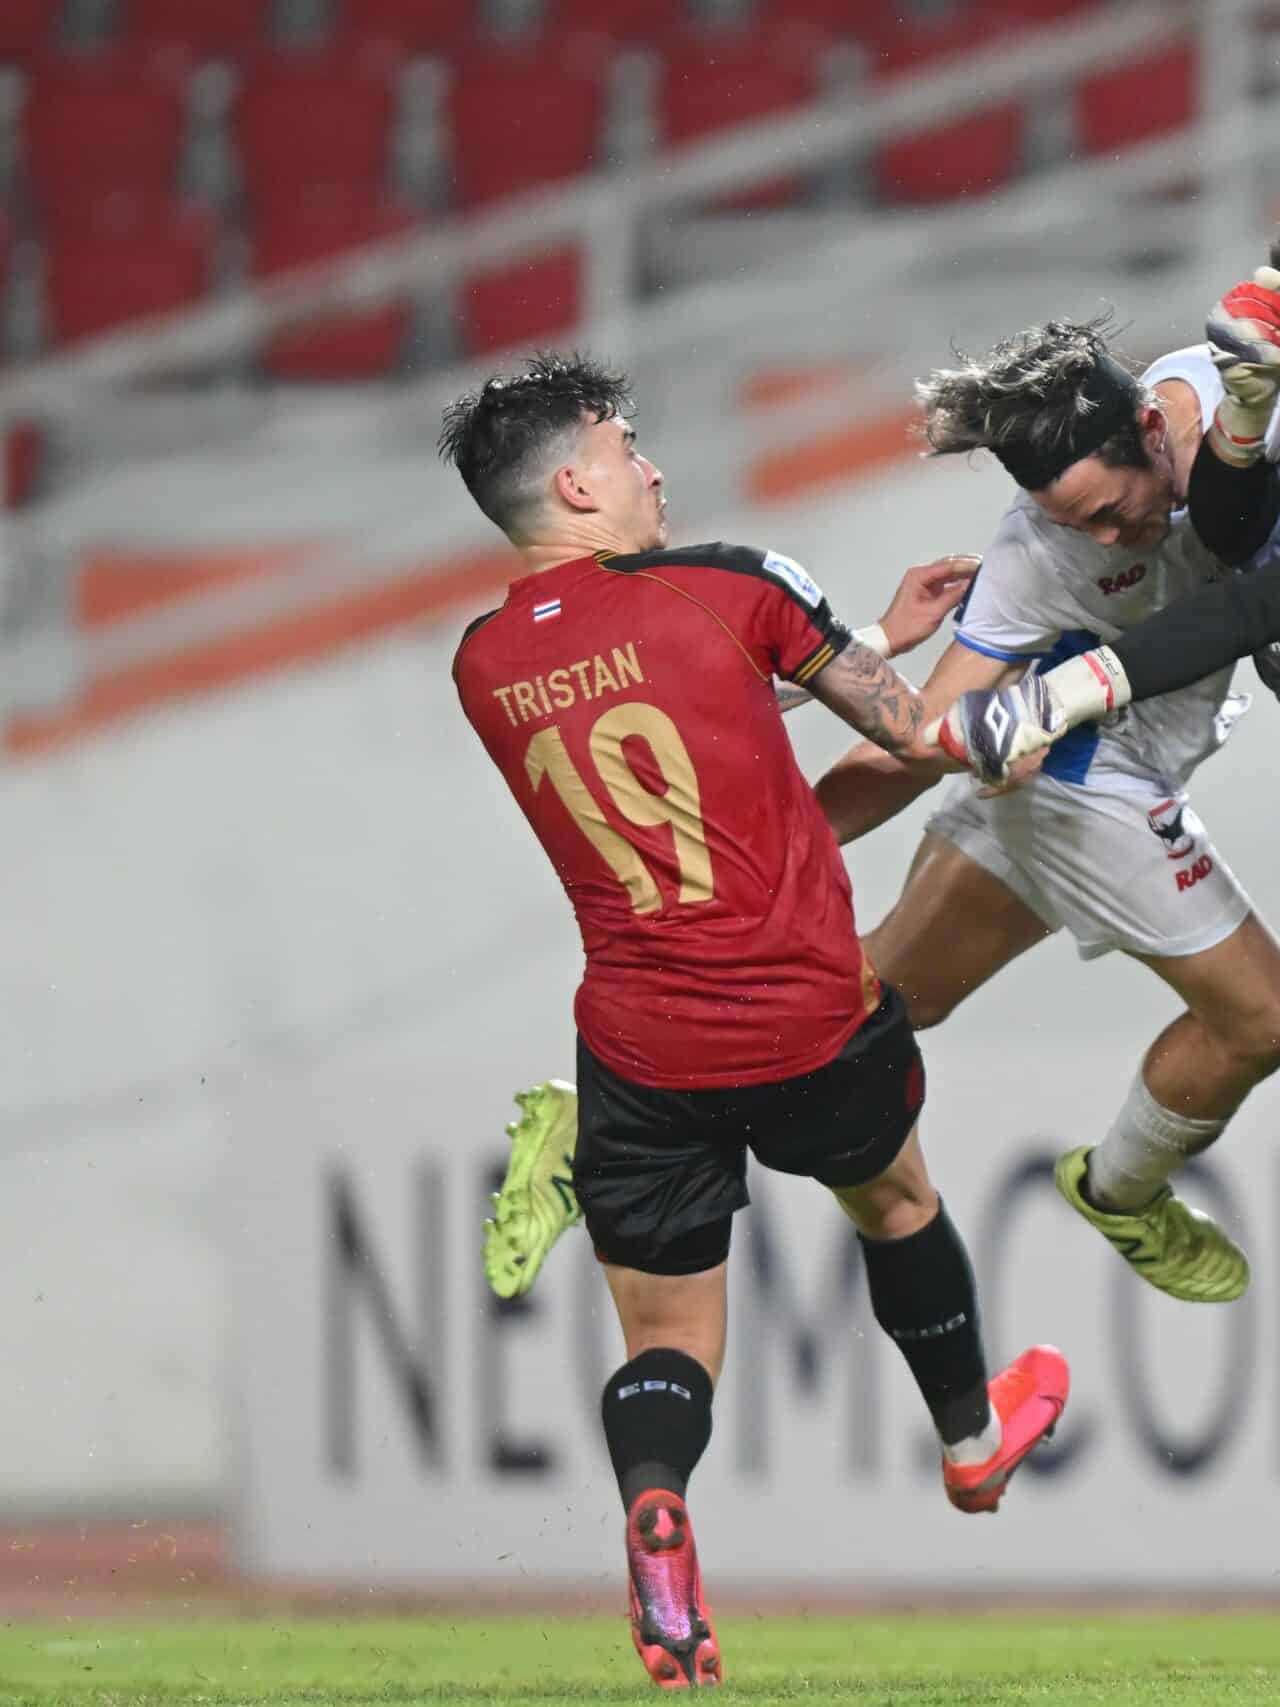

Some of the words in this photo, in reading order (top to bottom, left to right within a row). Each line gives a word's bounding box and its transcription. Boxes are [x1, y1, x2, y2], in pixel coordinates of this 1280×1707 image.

[1097, 563, 1146, 596] RAD
[523, 701, 714, 916] 19
[1175, 854, 1213, 893] RAD
[618, 1380, 691, 1400] EGO
